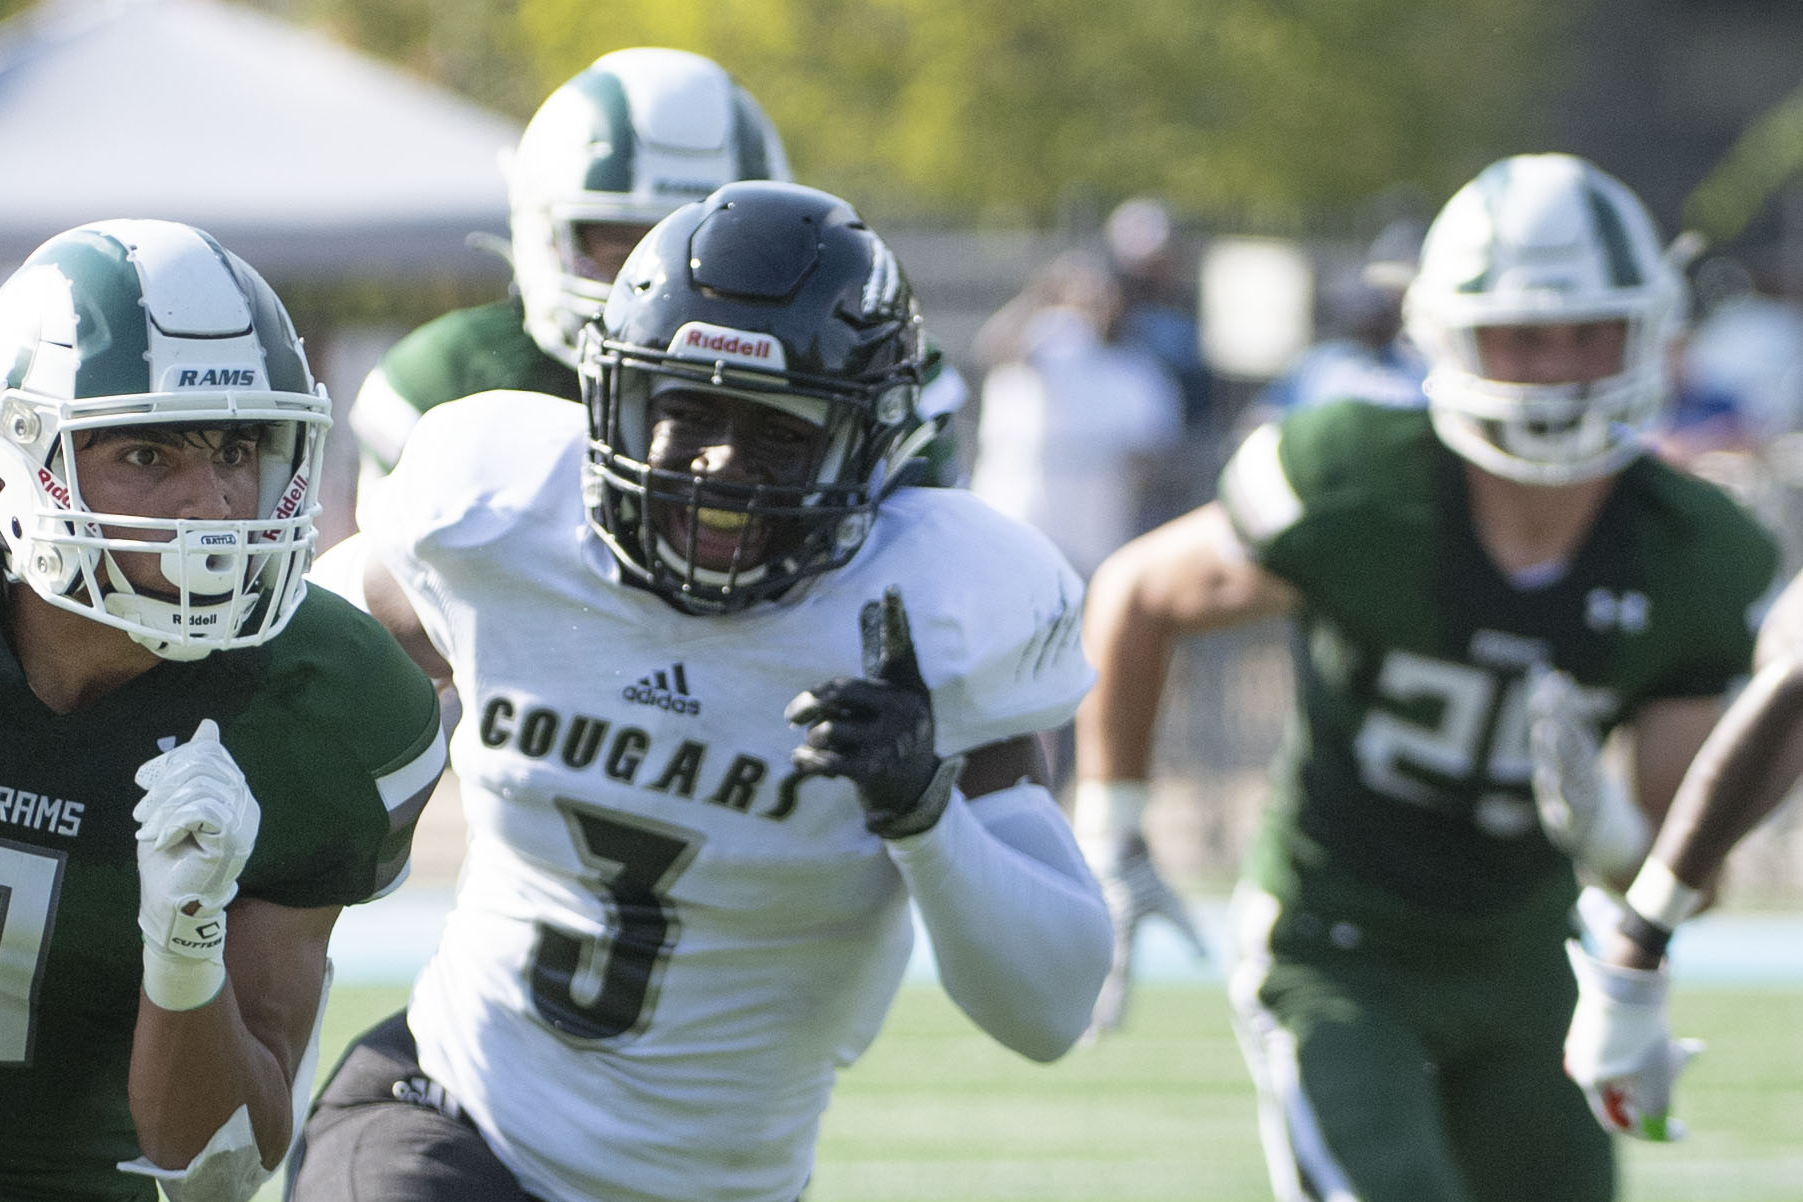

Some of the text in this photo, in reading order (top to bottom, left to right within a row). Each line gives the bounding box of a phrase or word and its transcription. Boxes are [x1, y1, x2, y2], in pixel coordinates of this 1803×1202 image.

[686, 329, 771, 358] Riddell
[178, 369, 255, 387] RAMS
[262, 474, 308, 541] Rddell
[172, 613, 217, 626] Rddell
[622, 685, 701, 716] adidas
[524, 795, 709, 1048] 3
